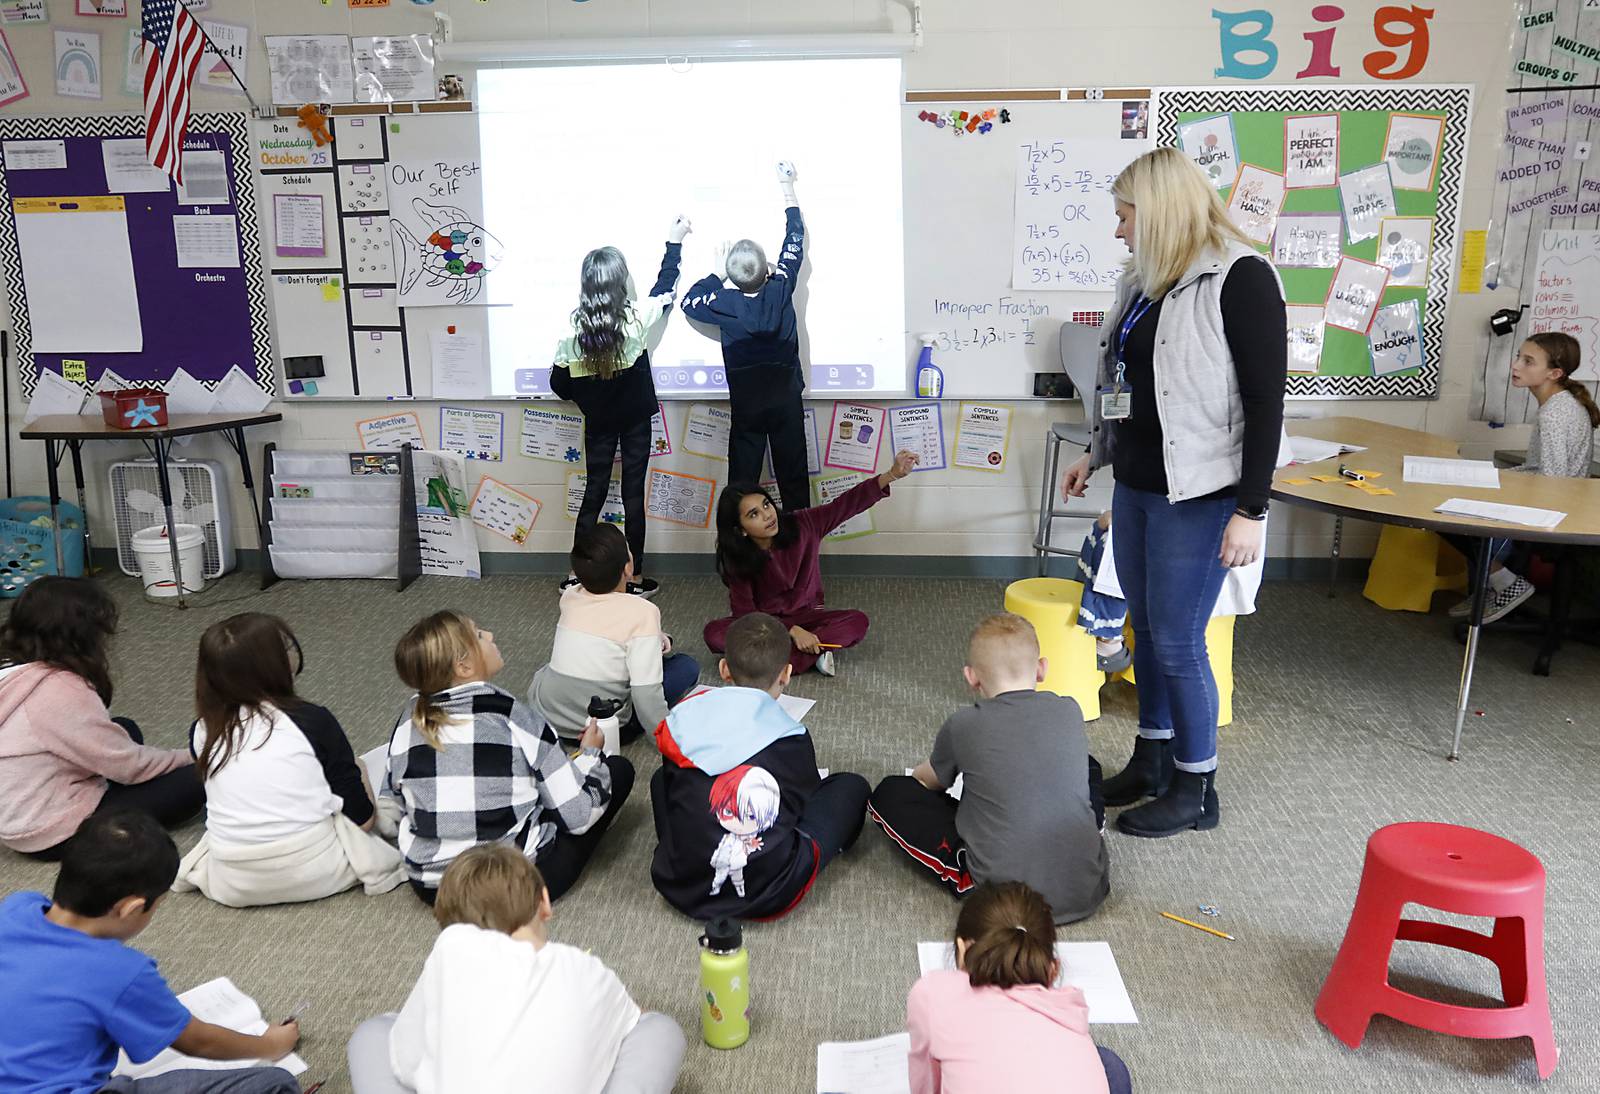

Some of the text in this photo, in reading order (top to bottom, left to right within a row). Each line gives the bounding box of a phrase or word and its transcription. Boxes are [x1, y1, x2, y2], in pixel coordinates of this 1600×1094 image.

[1523, 12, 1554, 28] EACH
[211, 24, 226, 41] LIFE
[1517, 61, 1579, 82] GROUPS OF
[1511, 98, 1565, 119] IN ADDITION
[1531, 117, 1544, 127] TO
[273, 124, 289, 134] Date
[182, 140, 211, 149] Schedule
[259, 138, 315, 150] Wednesday
[1290, 138, 1335, 150] PERFECT
[1506, 134, 1566, 155] MORE THAN
[261, 152, 327, 165] October 25
[391, 162, 481, 186] Our Best
[1500, 159, 1561, 182] ADDED TO
[282, 175, 312, 185] Schedule
[428, 179, 461, 198] Self
[1511, 185, 1569, 214] ALTOGETHER
[194, 206, 211, 215] Band
[1063, 204, 1091, 221] OR
[1550, 204, 1578, 215] SUM
[1289, 225, 1329, 244] Always
[1542, 231, 1580, 252] Unit
[195, 272, 226, 283] Orchestra
[287, 275, 329, 285] Don't Forget!
[1538, 270, 1573, 288] factors
[1535, 291, 1560, 303] rows
[998, 296, 1050, 317] Fraction
[1374, 335, 1418, 352] ENOUGH.
[64, 361, 83, 370] Extra
[472, 412, 496, 420] Speech
[524, 409, 583, 424] Possessive Nouns
[850, 406, 869, 415] SIMPLE
[898, 408, 930, 416] COMPOUND
[973, 407, 998, 415] COMPLEX
[368, 416, 407, 430] Adjective
